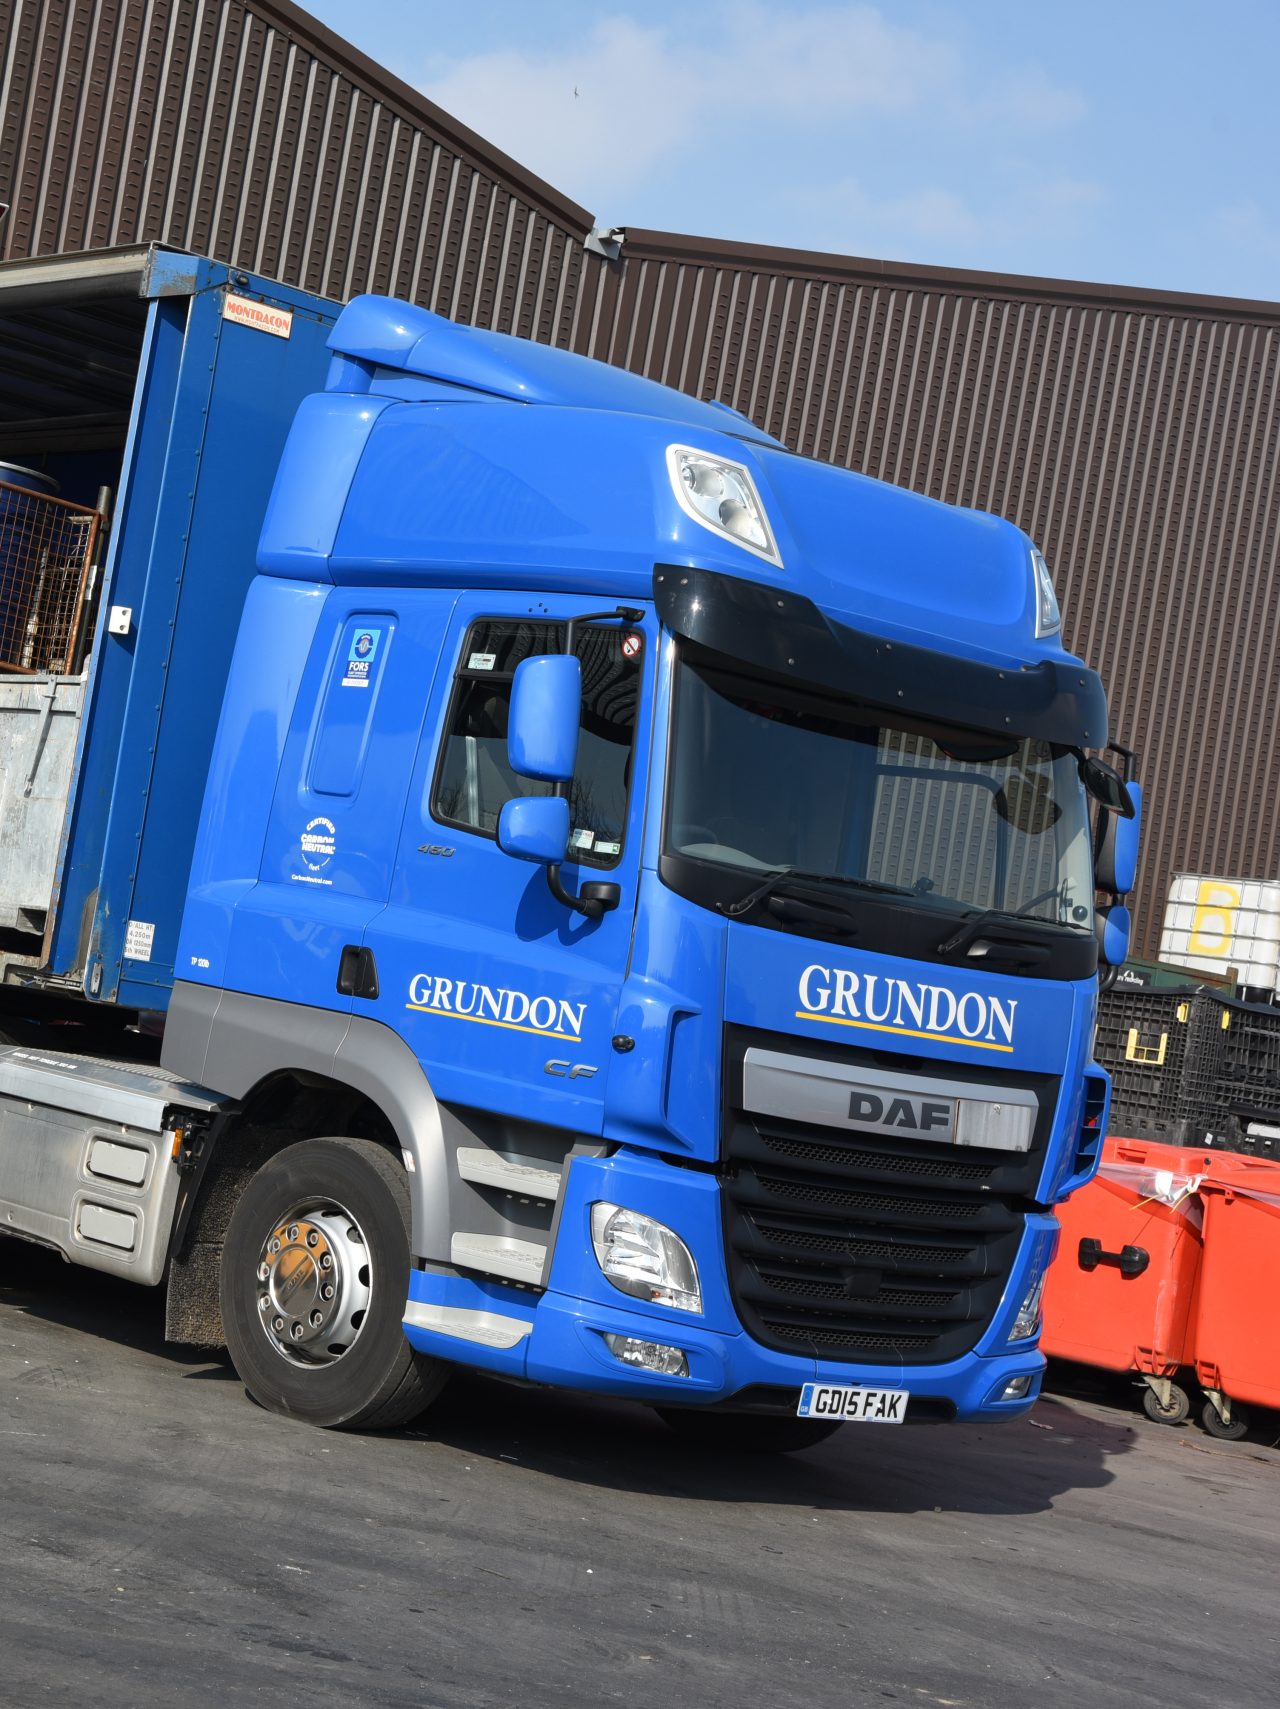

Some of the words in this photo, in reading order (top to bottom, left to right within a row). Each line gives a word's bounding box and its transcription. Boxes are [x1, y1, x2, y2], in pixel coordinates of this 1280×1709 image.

[227, 302, 290, 330] MONTRACON
[349, 661, 369, 671] FORS
[301, 833, 335, 844] CARBON
[1189, 881, 1240, 956] B
[129, 931, 151, 939] 4.250m
[409, 973, 588, 1036] GRUNDON
[799, 964, 1018, 1044] GRUNDON
[544, 1059, 599, 1079] CF
[848, 1091, 950, 1131] DAF
[815, 1389, 860, 1415] GD15
[862, 1393, 902, 1419] FAK
